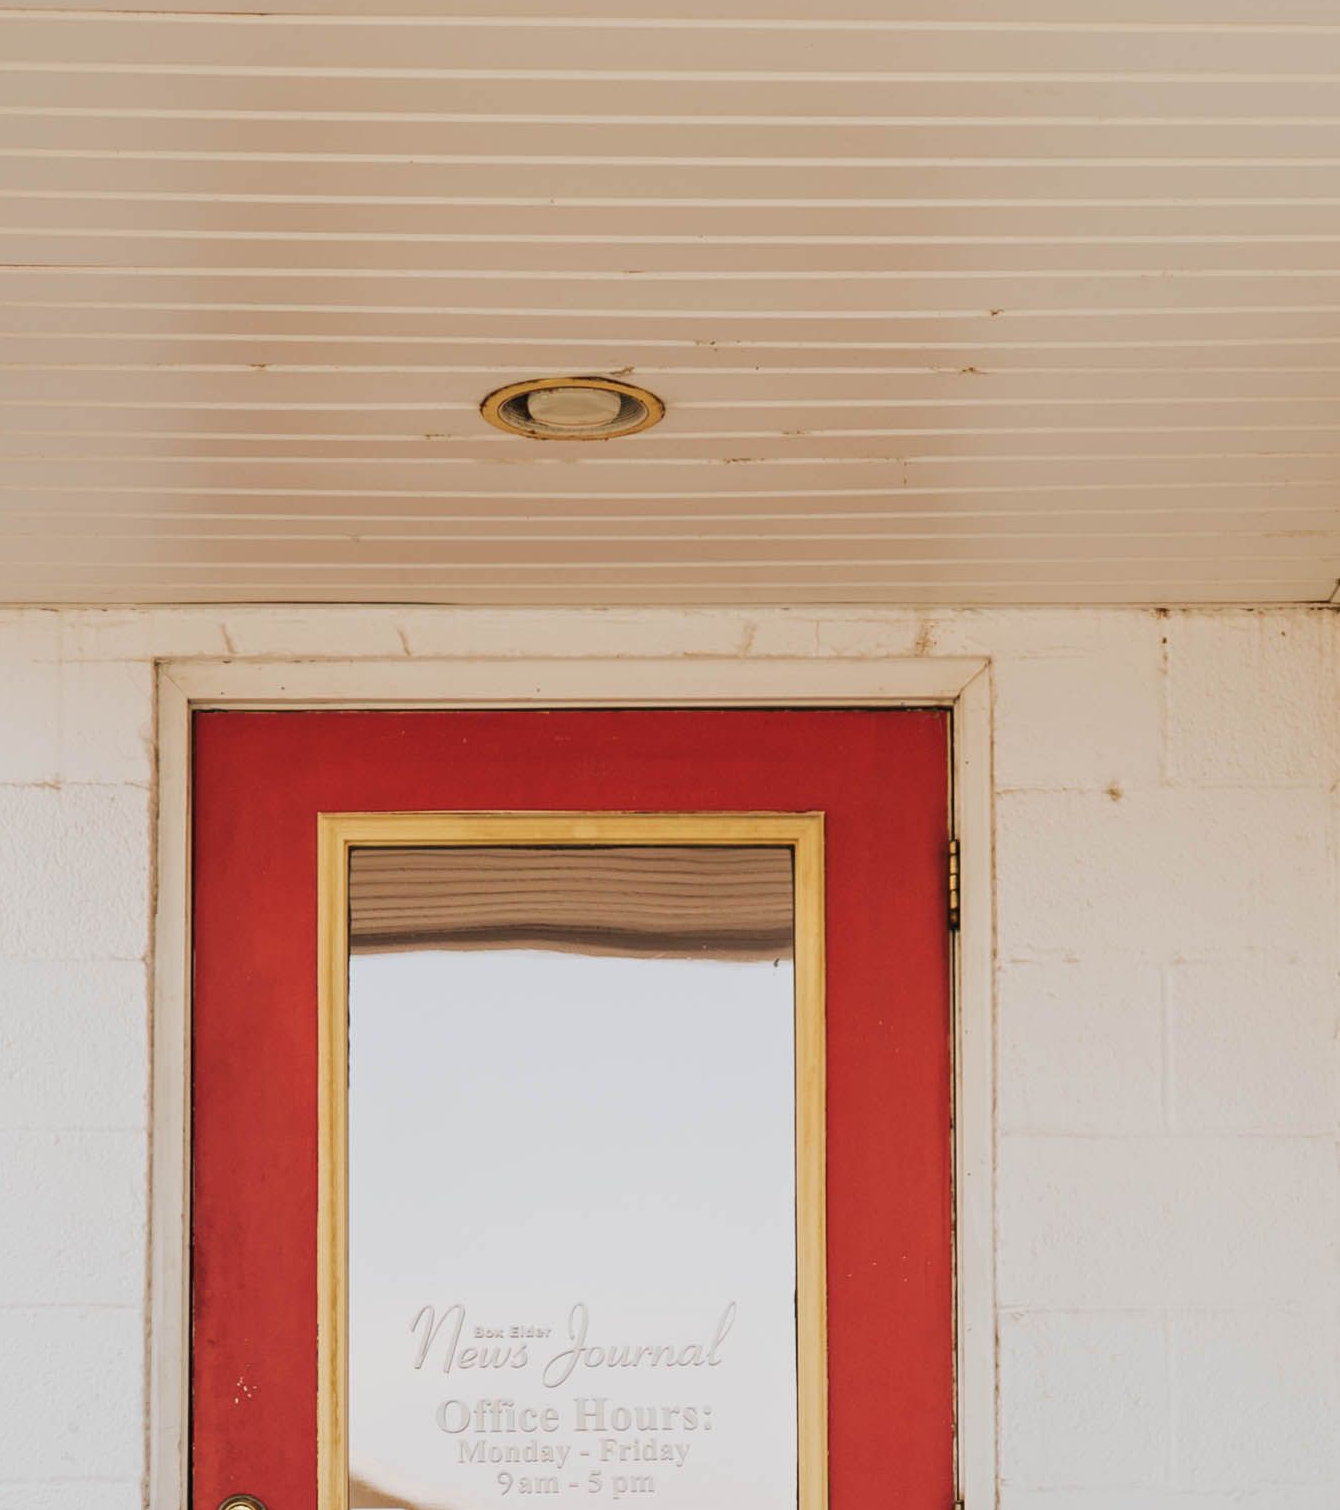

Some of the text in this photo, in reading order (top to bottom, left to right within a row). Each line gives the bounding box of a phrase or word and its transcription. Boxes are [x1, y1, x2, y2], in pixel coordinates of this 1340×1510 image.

[410, 1300, 737, 1389] News Journal
[474, 1325, 552, 1339] Box Elder
[437, 1397, 713, 1434] Office Hours:
[457, 1438, 570, 1469] Monday
[600, 1438, 691, 1468] Friday
[588, 1469, 603, 1495] 5
[613, 1475, 655, 1499] pm
